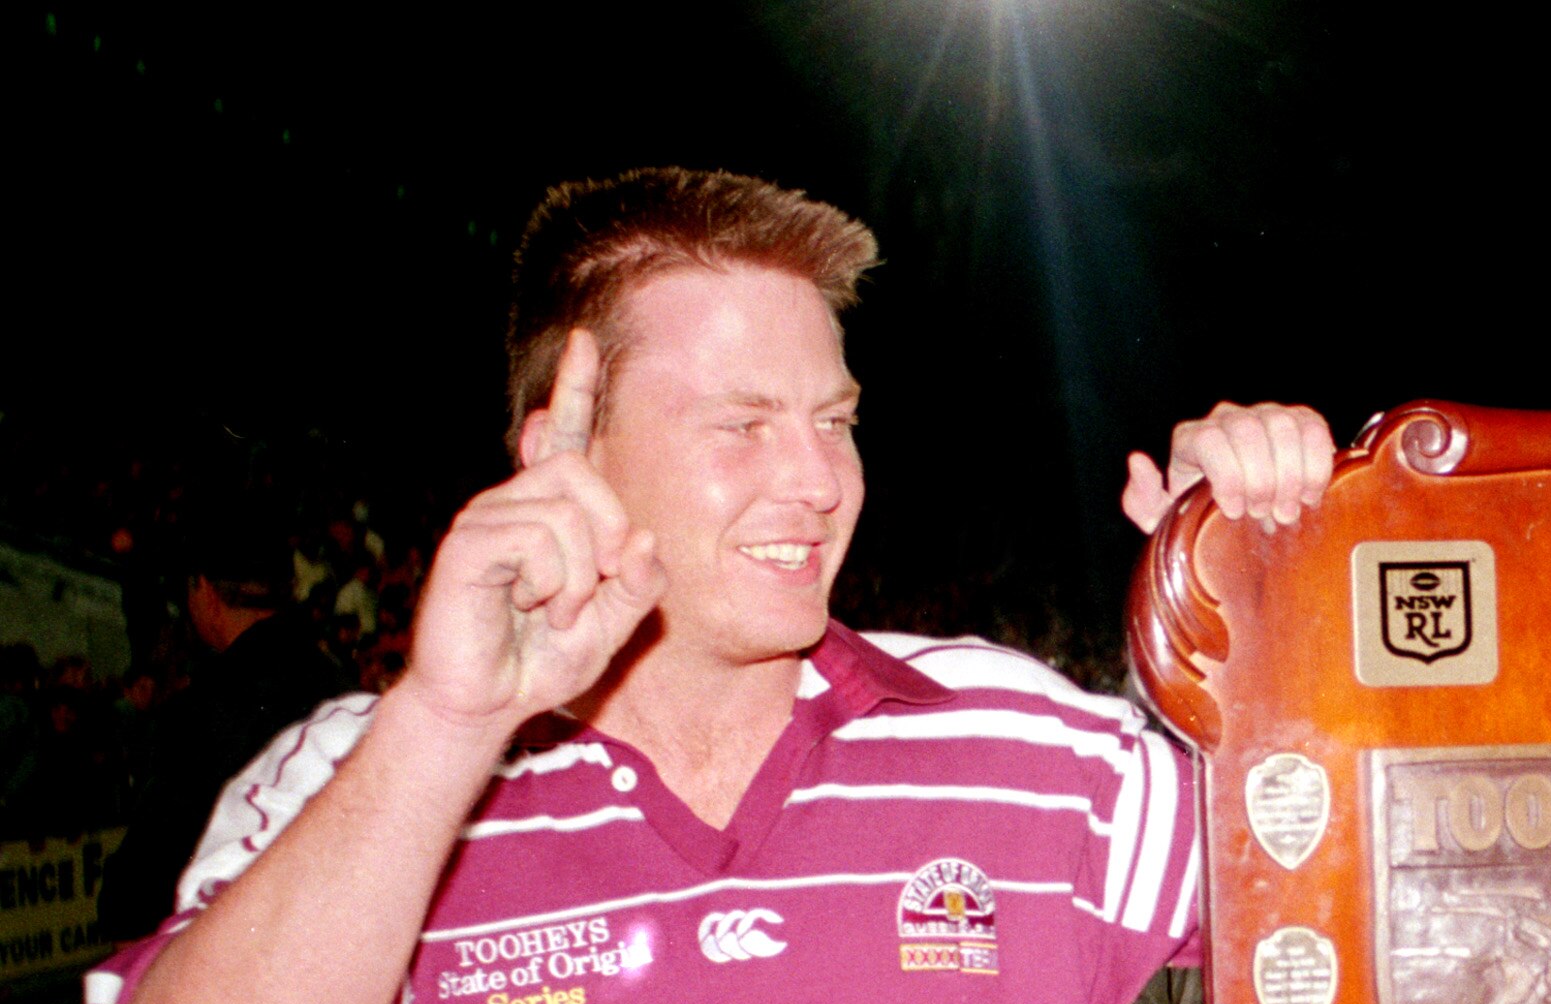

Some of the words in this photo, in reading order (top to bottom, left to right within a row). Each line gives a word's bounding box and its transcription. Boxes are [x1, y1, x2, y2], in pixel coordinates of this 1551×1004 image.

[1395, 595, 1457, 610] NSW
[1405, 611, 1452, 648] RL
[455, 916, 610, 967] TOOHEYS
[438, 968, 507, 999] State
[511, 956, 544, 987] of
